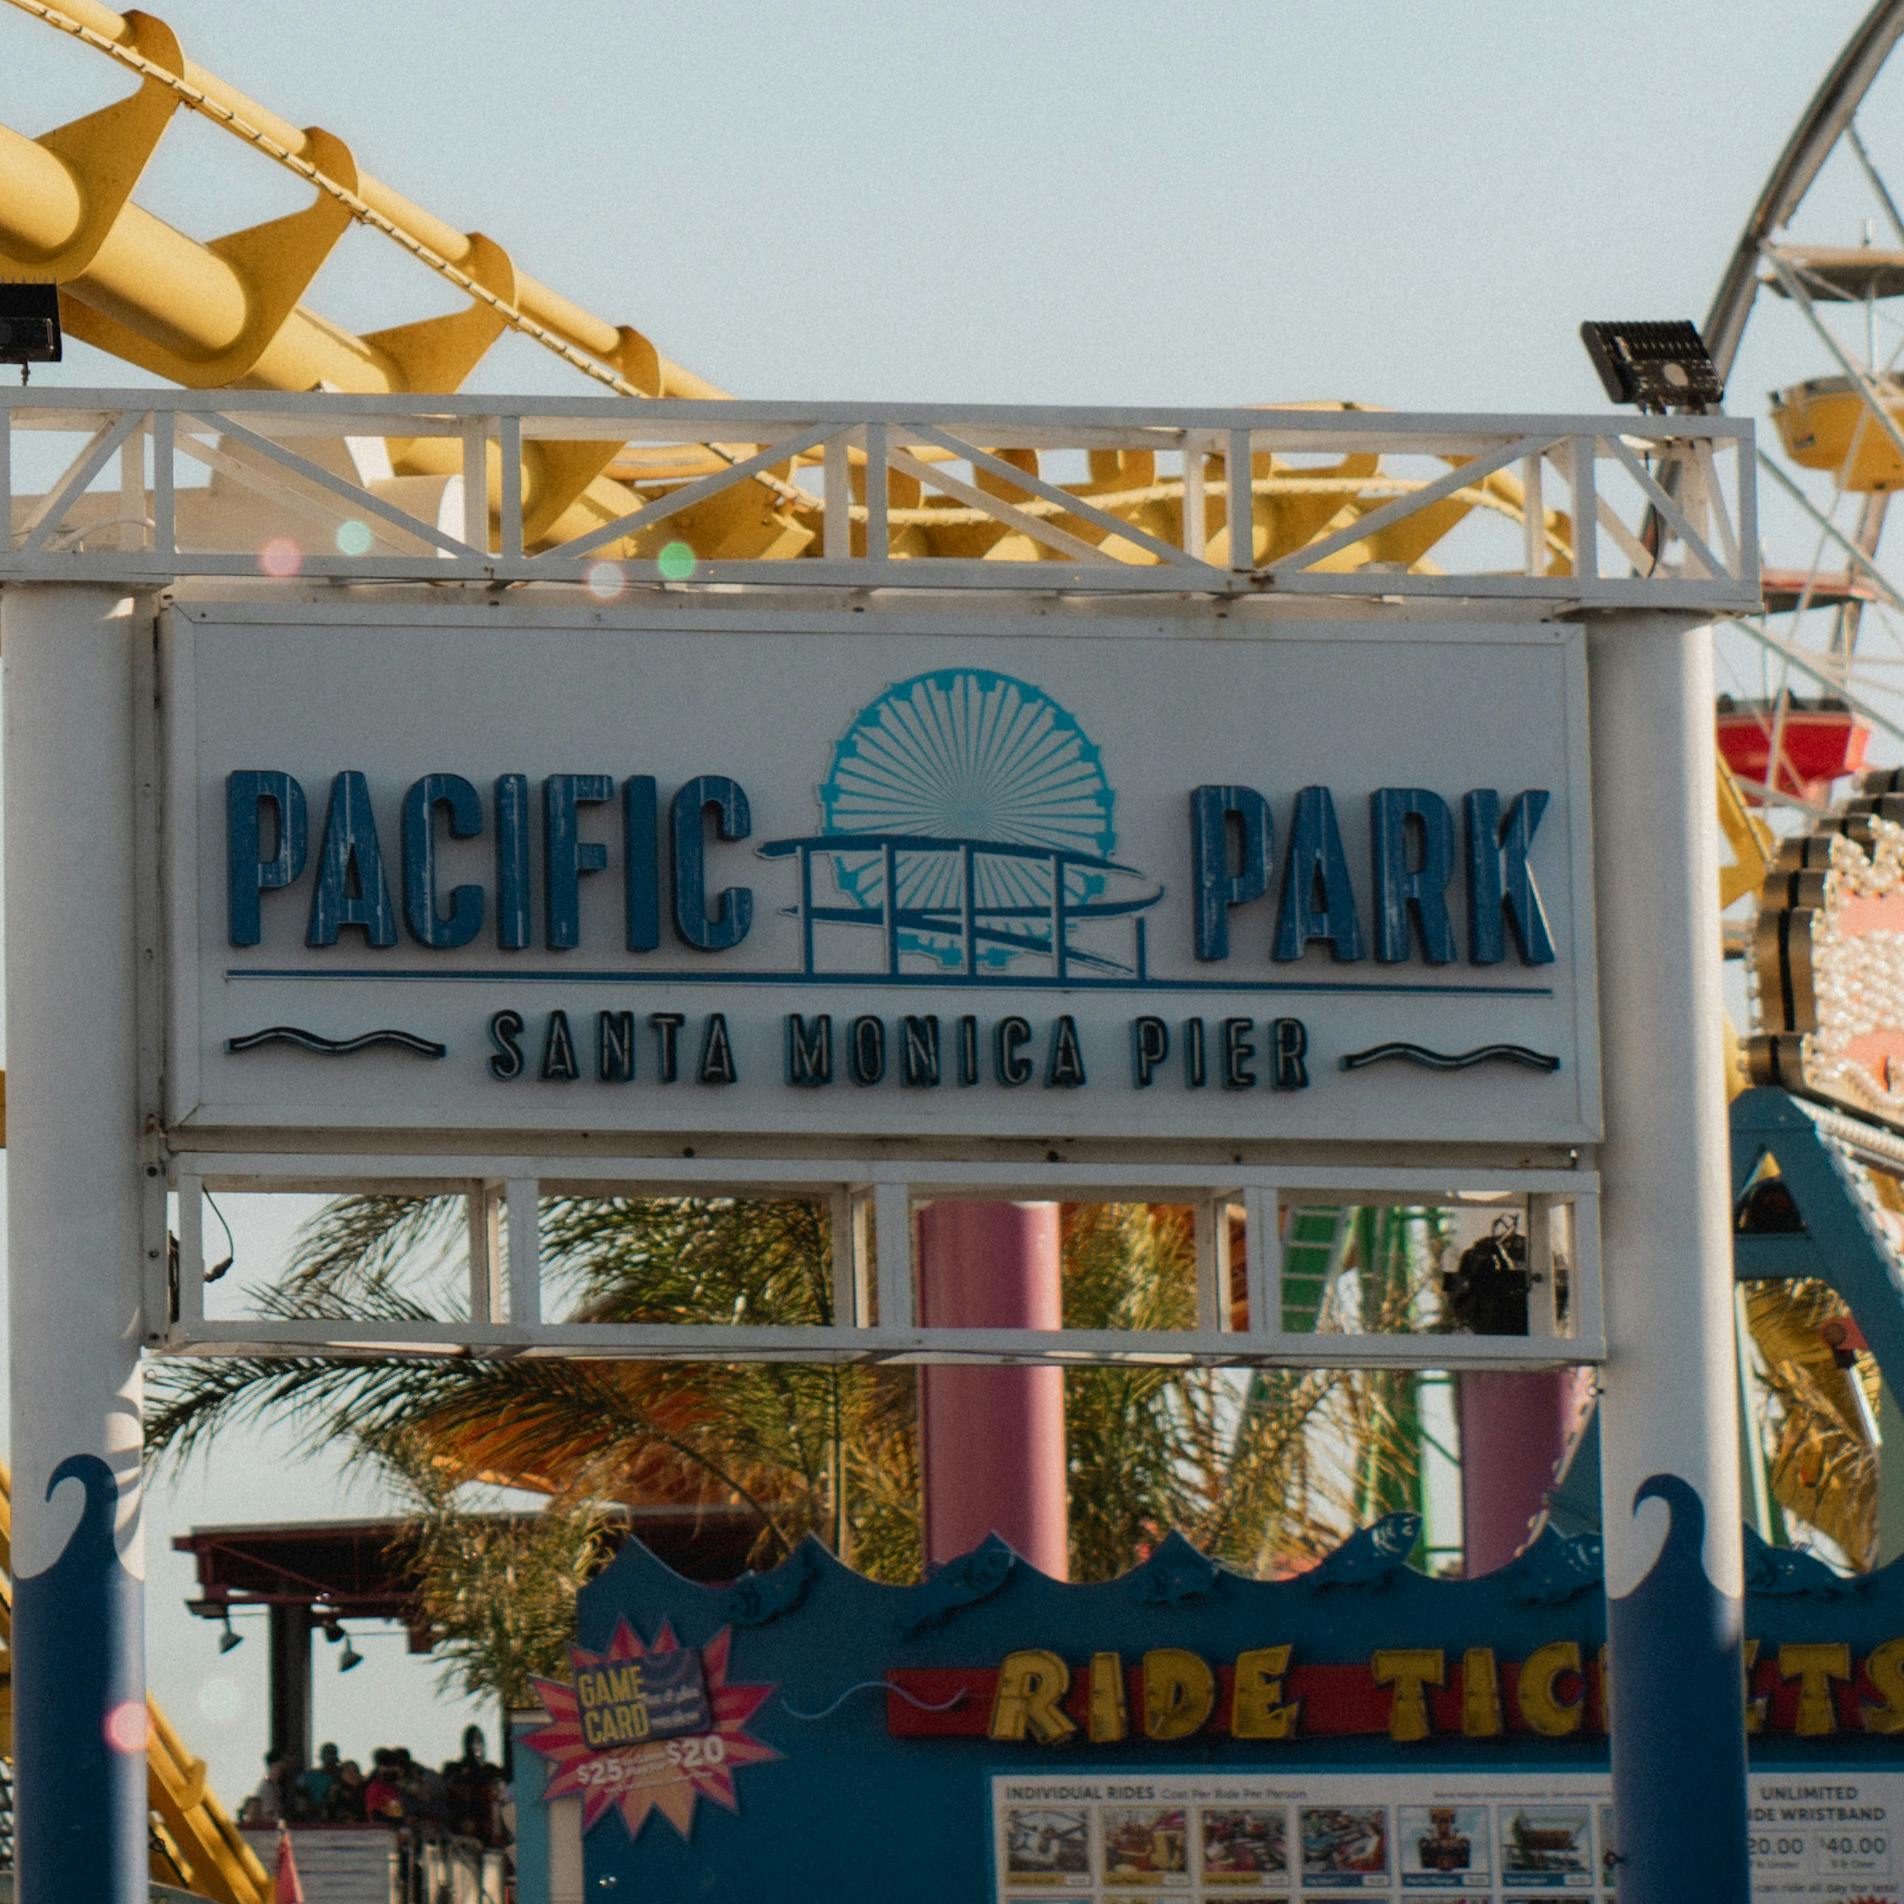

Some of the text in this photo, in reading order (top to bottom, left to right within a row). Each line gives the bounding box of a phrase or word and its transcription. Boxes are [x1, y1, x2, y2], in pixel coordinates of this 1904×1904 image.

[225, 770, 1555, 965] PACIFIC PARK
[488, 1010, 1309, 1090] SANTA MONICA PIER
[578, 1666, 644, 1707] GAME
[989, 1637, 1904, 1744] RIDE TICTS
[584, 1703, 651, 1744] CARD
[576, 1758, 623, 1784] $25
[664, 1734, 725, 1768] $20
[1006, 1786, 1101, 1800] INDIVIDUAL
[1107, 1786, 1155, 1800] RIDES
[1760, 1786, 1858, 1801] UNLIMITED
[1747, 1807, 1886, 1821] IDE WRISTBAND
